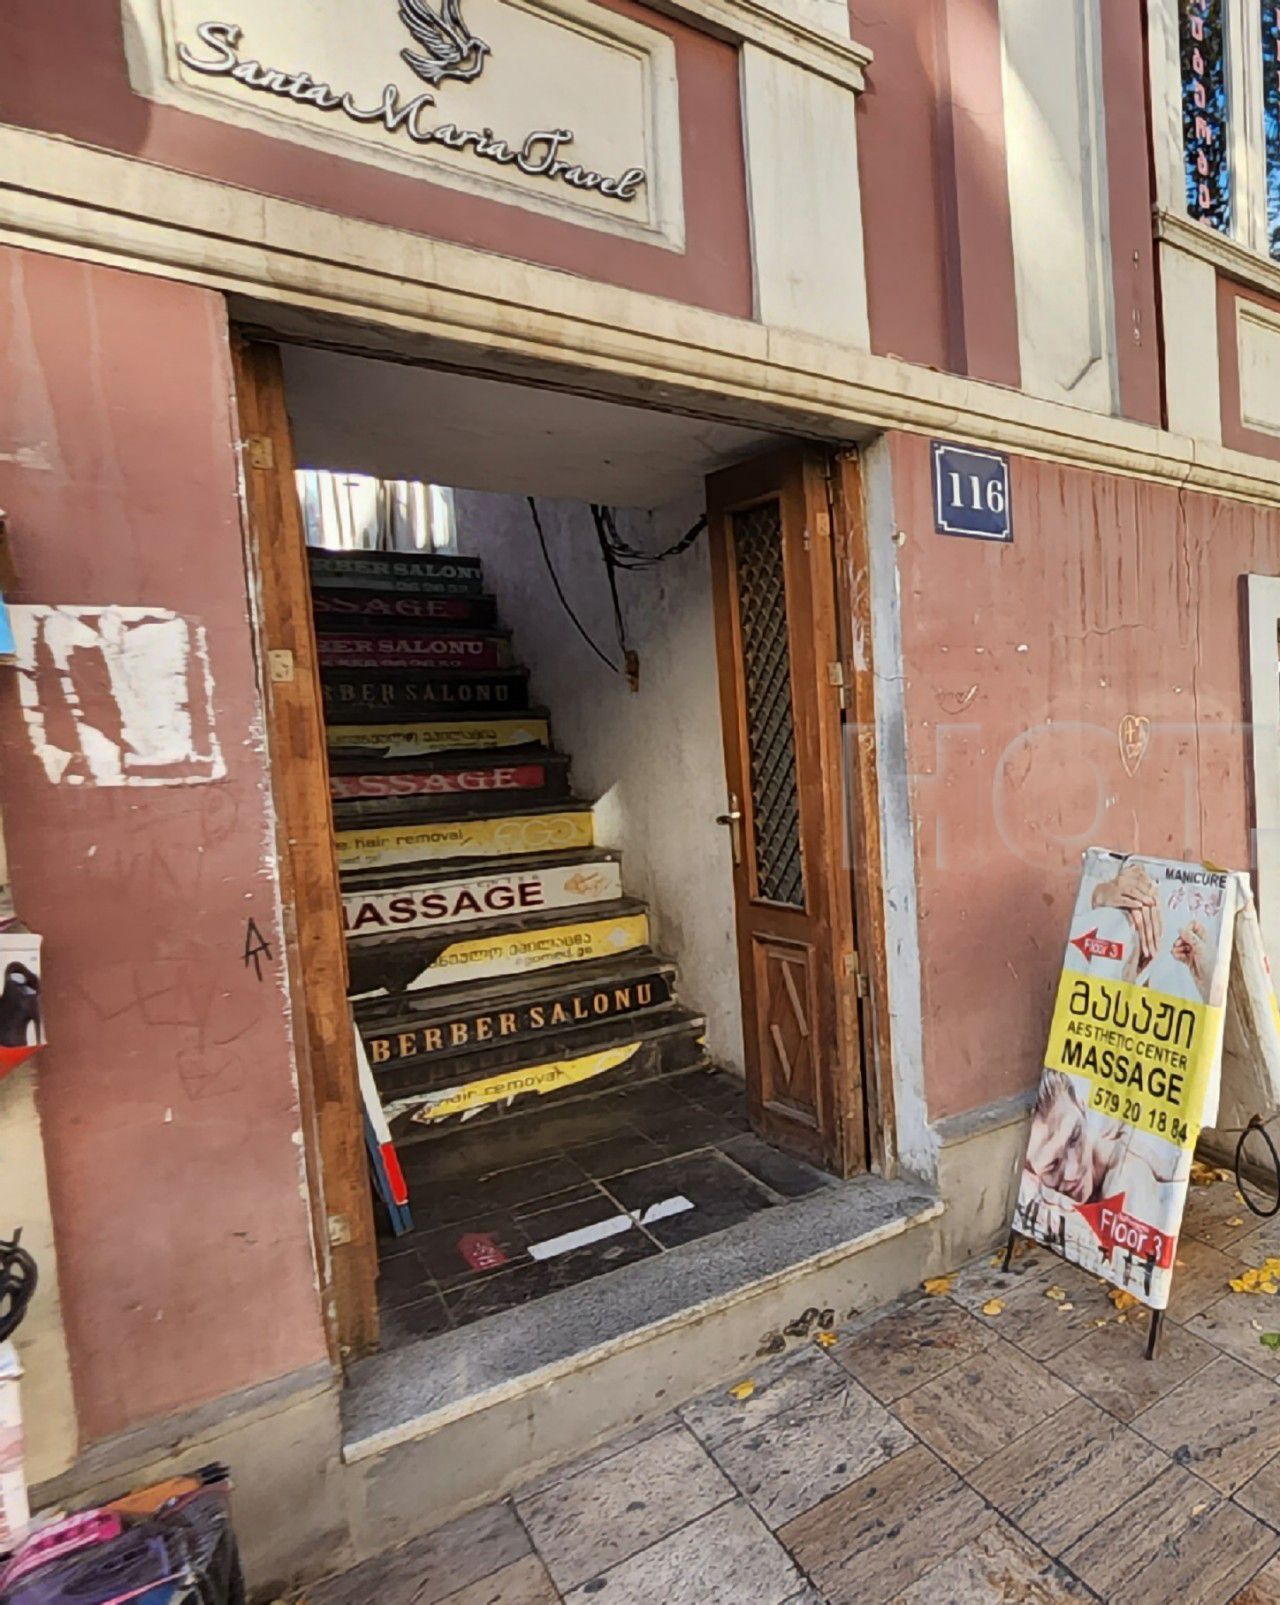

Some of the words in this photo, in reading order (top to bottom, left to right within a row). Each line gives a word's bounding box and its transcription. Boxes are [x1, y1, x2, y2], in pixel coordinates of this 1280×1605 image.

[178, 22, 342, 108] Santa
[340, 84, 515, 164] Maria
[512, 128, 646, 202] Travel
[947, 472, 1004, 513] 116
[378, 640, 483, 655] SALONU
[406, 684, 509, 702] SALONU
[355, 836, 389, 849] hair
[396, 829, 465, 845] removal
[1166, 867, 1228, 888] MANICURE
[342, 882, 544, 931] ASSAGE
[370, 1012, 517, 1064] BERBER
[530, 983, 653, 1029] SALONU
[1068, 980, 1196, 1049] მასაჟი
[1066, 1020, 1134, 1050] AESTHETIC
[1136, 1039, 1188, 1072] CENTER
[1060, 1039, 1184, 1106] MASSAGE
[1093, 1087, 1120, 1113] 579
[1122, 1102, 1141, 1124] 20
[1149, 1109, 1167, 1134] 18
[1170, 1117, 1188, 1144] 84
[1100, 1208, 1147, 1253] Floor
[1152, 1235, 1164, 1263] 3
